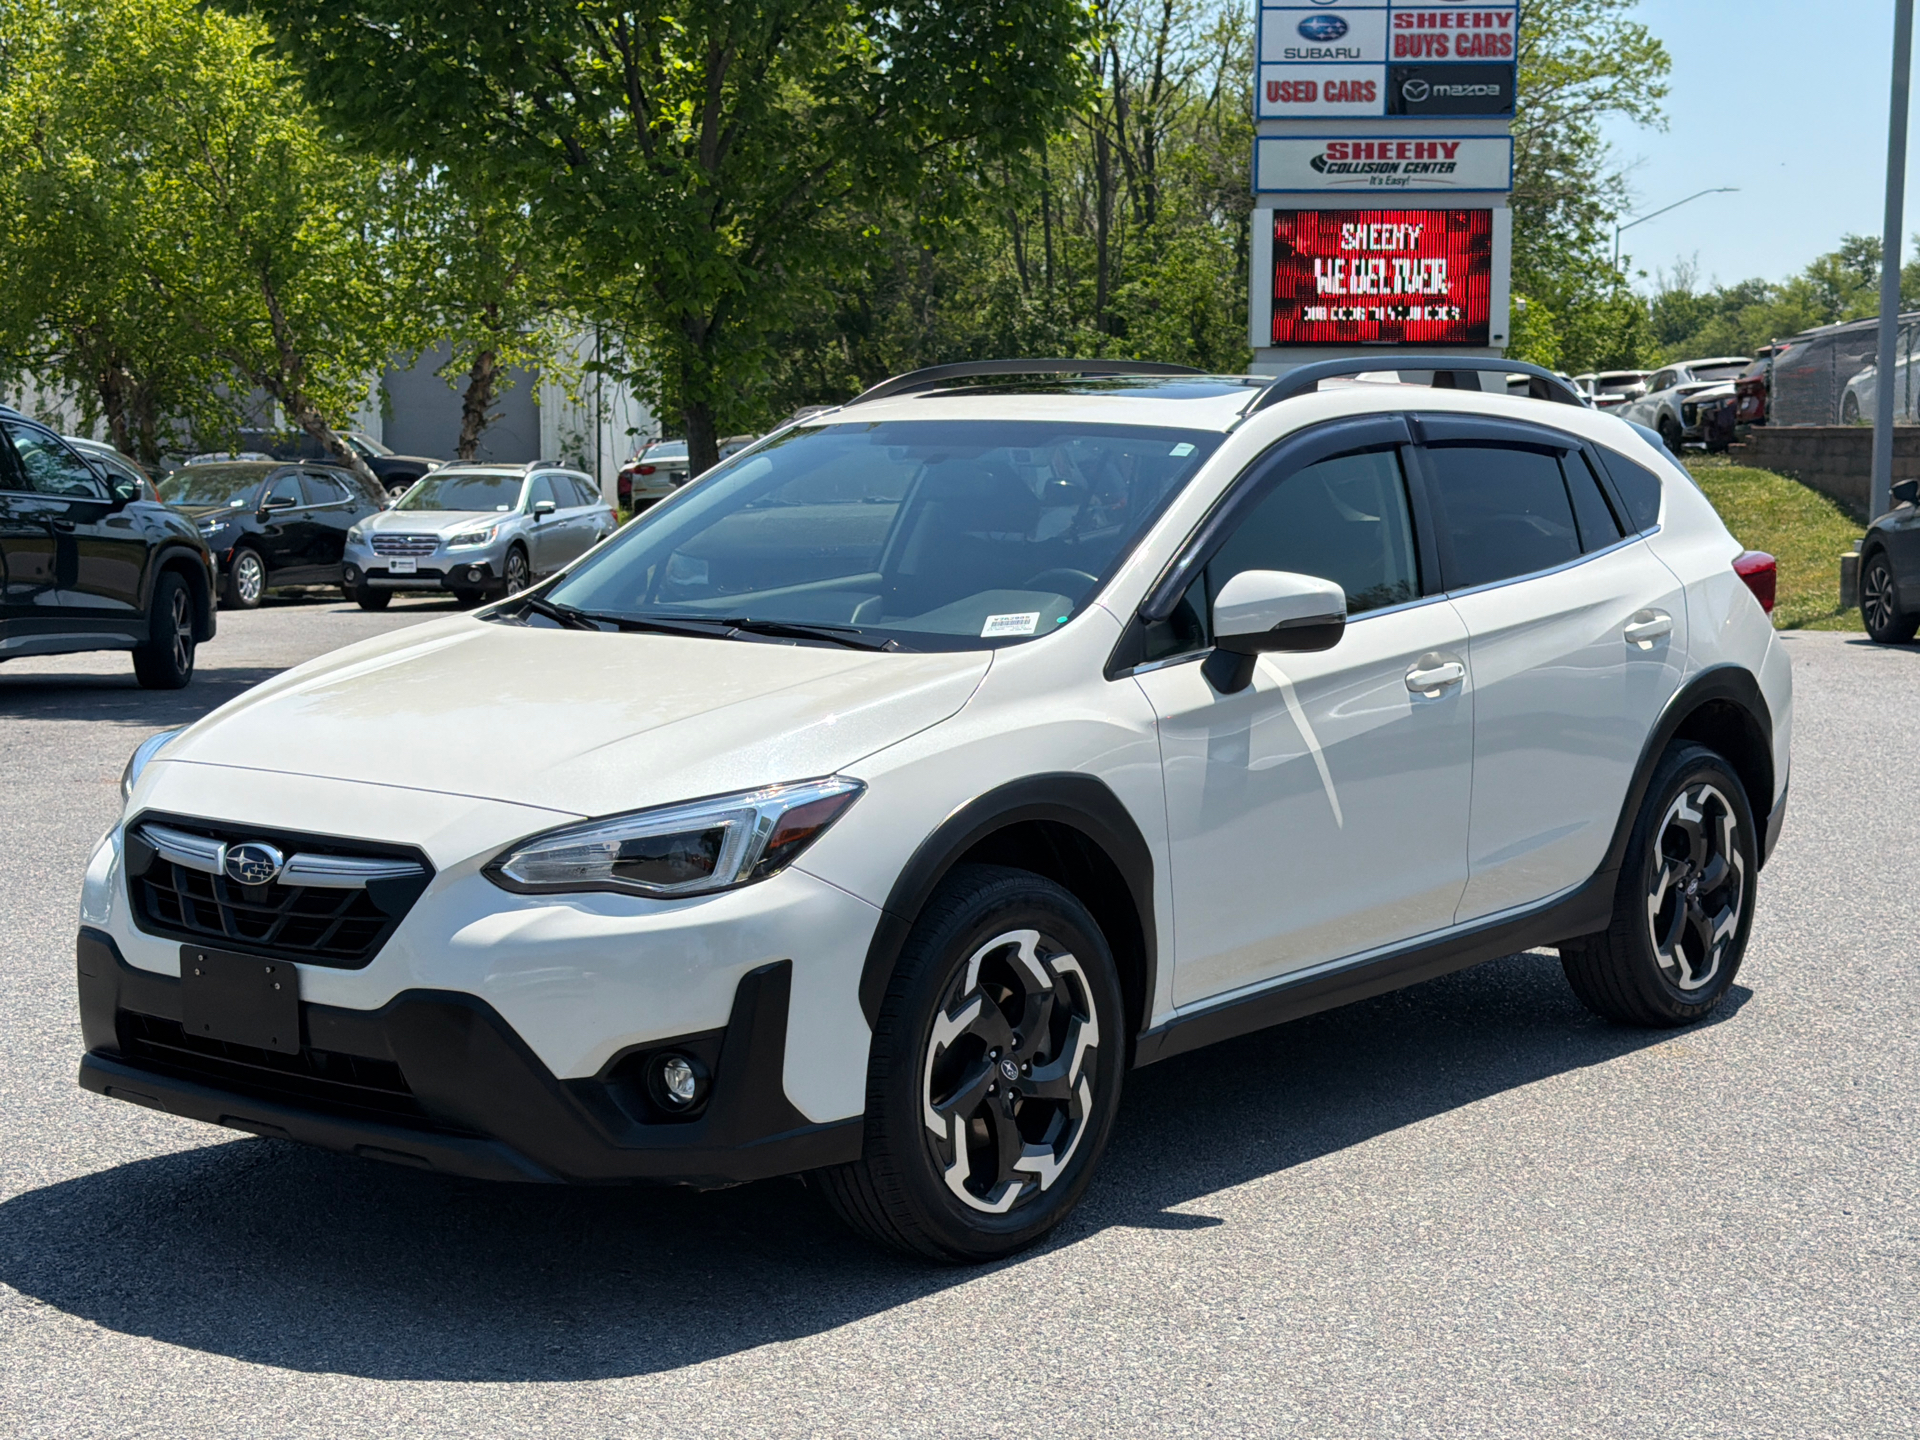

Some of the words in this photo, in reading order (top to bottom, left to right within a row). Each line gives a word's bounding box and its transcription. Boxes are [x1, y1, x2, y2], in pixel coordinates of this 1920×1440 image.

[1394, 12, 1513, 29] SHEEHY
[1283, 47, 1361, 59] SUBARU
[1394, 33, 1449, 58] BUYS
[1455, 32, 1513, 58] CARS
[1266, 80, 1318, 103] USED
[1323, 80, 1376, 103] CARS
[1326, 141, 1460, 160] SHEEHY
[1326, 162, 1400, 174] COLLISION
[1402, 161, 1457, 174] CENTER
[1369, 175, 1383, 185] It's
[1385, 175, 1411, 186] Easy!
